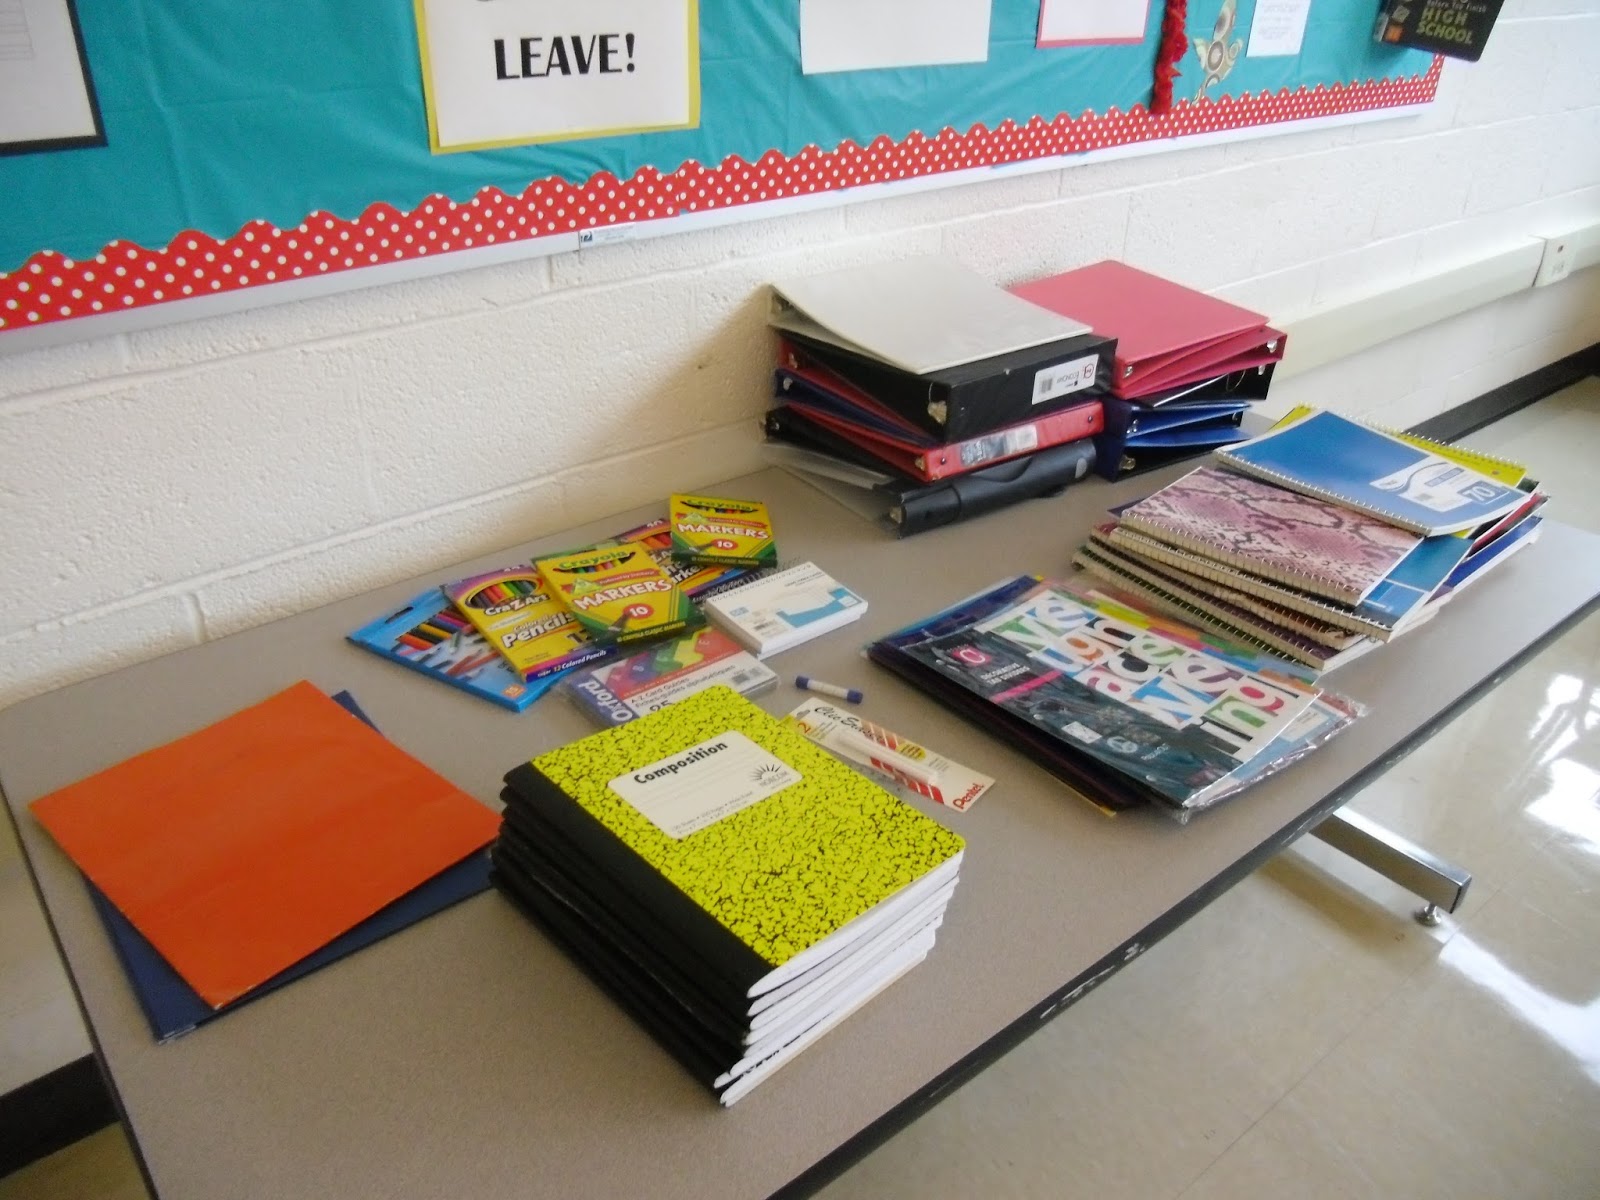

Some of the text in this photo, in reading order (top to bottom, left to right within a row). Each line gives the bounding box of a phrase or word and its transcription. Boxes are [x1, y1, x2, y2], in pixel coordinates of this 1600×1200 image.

[1420, 6, 1469, 26] HIGH
[1416, 21, 1473, 44] SCHOOL
[494, 33, 635, 80] LEAVE!
[1462, 485, 1496, 502] 70
[687, 499, 755, 512] Crayola
[677, 523, 769, 539] MARKERS
[716, 540, 734, 549] 10
[558, 550, 630, 570] Crayola
[574, 580, 672, 610] MARKERS
[630, 606, 648, 618] 10
[502, 612, 575, 648] Pencils
[562, 655, 585, 670] Colored
[585, 649, 607, 662] Pencils
[578, 680, 633, 722] Oxford
[797, 721, 811, 734] 2
[633, 741, 729, 784] Composition
[953, 783, 984, 810] Pentel
